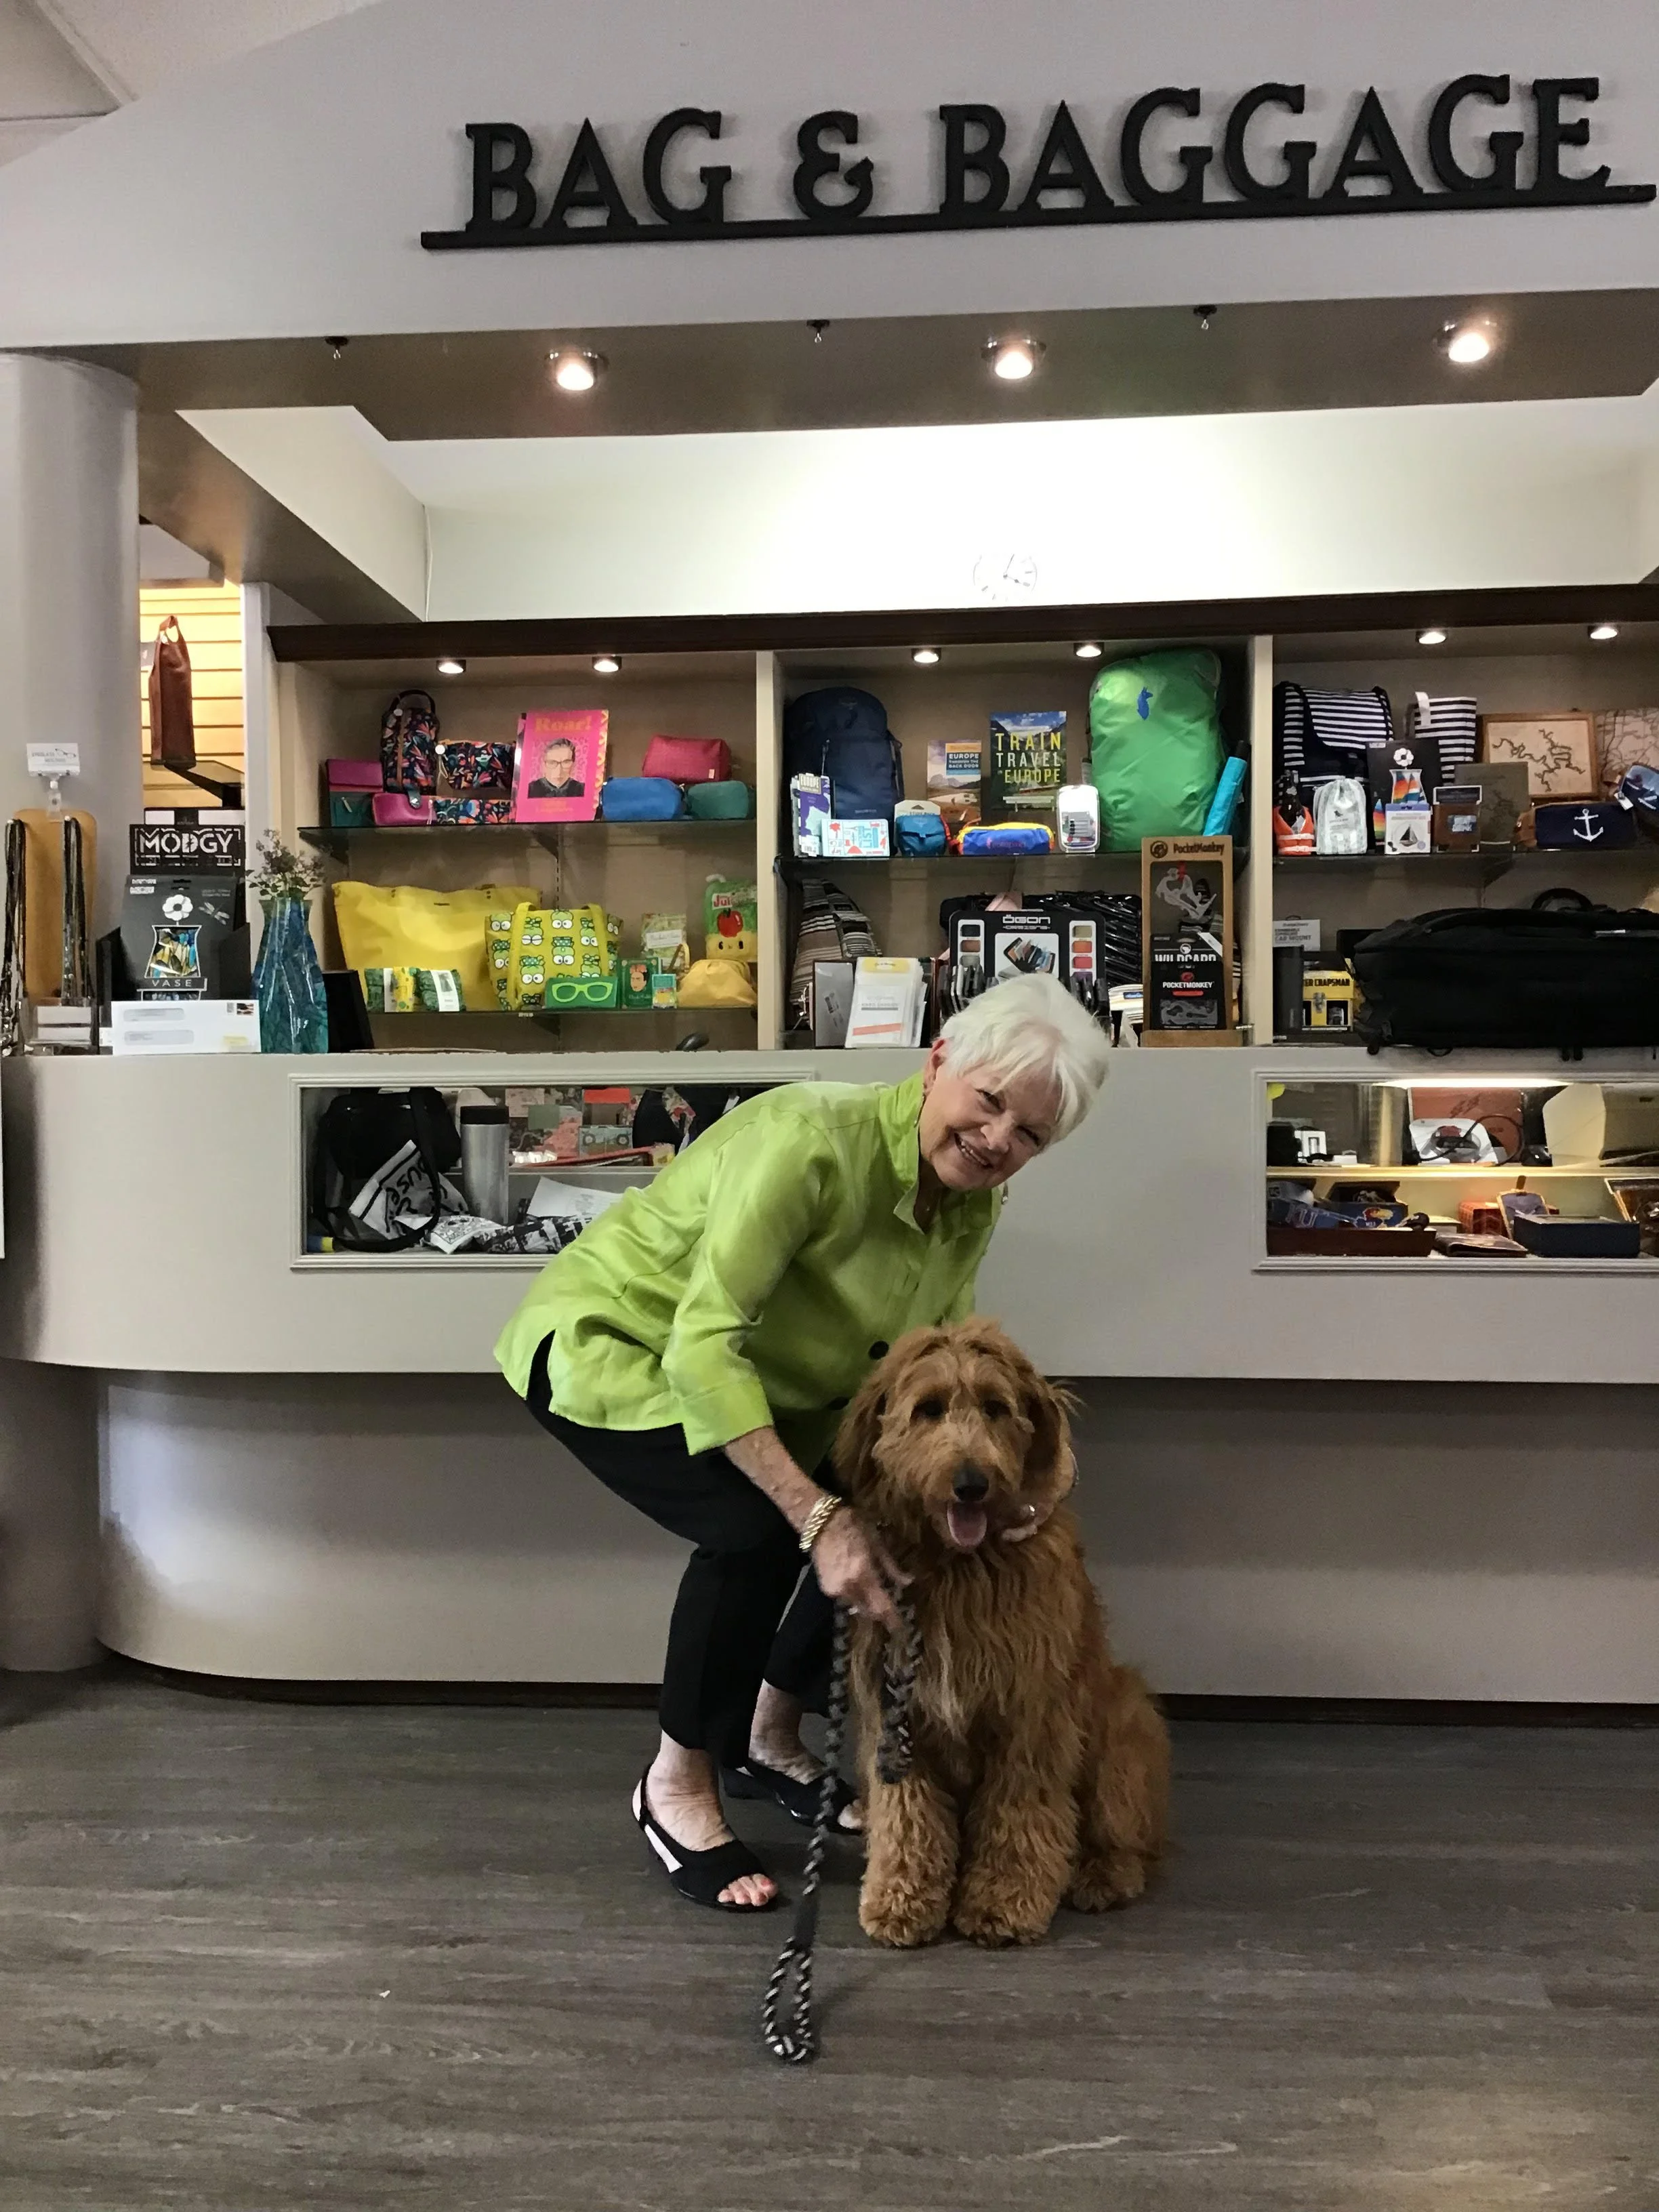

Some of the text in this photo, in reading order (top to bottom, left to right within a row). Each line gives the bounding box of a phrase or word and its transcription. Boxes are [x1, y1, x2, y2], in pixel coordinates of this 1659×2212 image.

[466, 74, 1611, 233] BAG & BAGGAGE
[535, 716, 592, 733] Roar!
[995, 732, 1061, 752] TRAIN
[996, 752, 1061, 768] TRAVEL
[1004, 769, 1061, 783] EUROPE
[140, 832, 234, 854] MODGY
[1173, 842, 1225, 855] PocketMonkey
[151, 979, 192, 987] VASE
